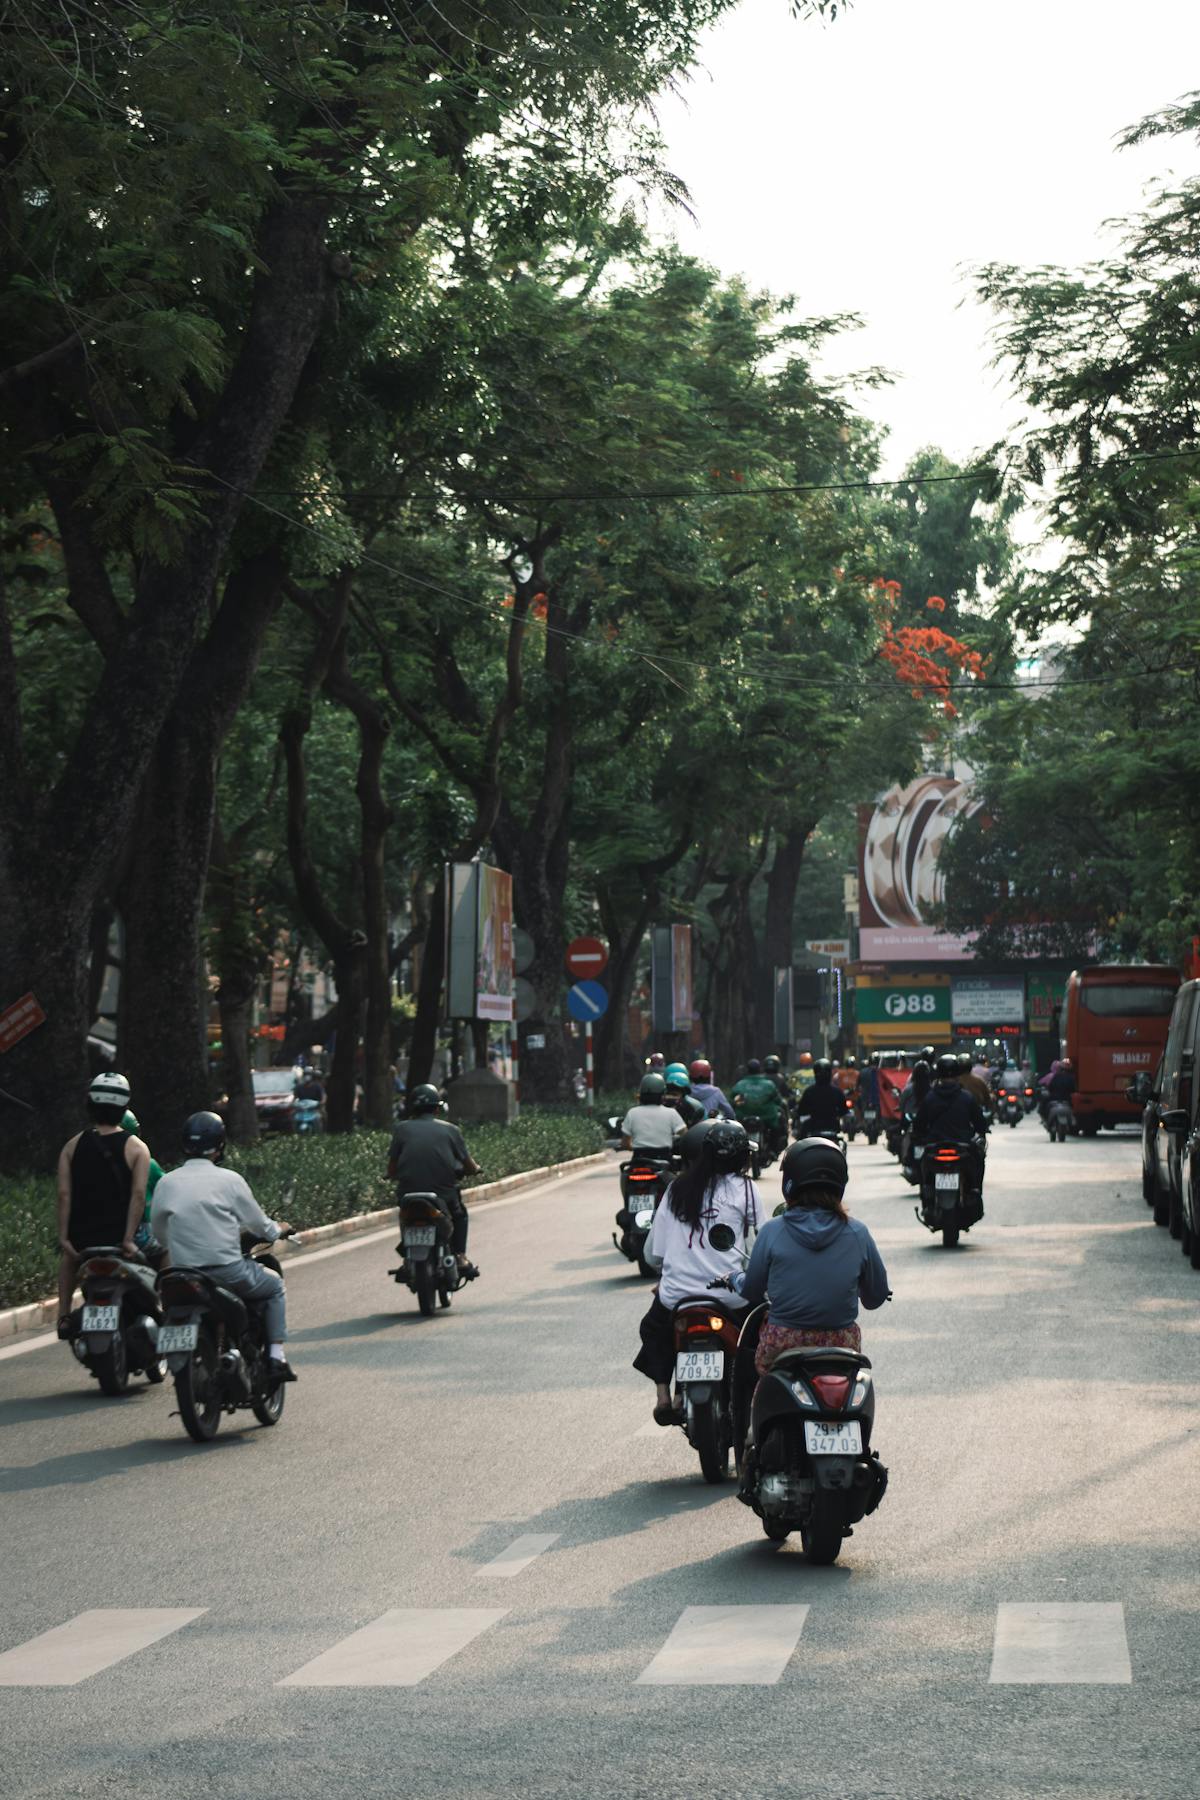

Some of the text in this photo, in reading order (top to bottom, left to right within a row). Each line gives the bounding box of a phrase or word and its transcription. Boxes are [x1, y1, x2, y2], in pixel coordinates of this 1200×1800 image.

[885, 994, 936, 1016] F88
[685, 1353, 716, 1366] 20-B1
[680, 1366, 720, 1379] 709.25
[814, 1423, 852, 1437] 29-P1
[810, 1438, 858, 1452] 347.03
